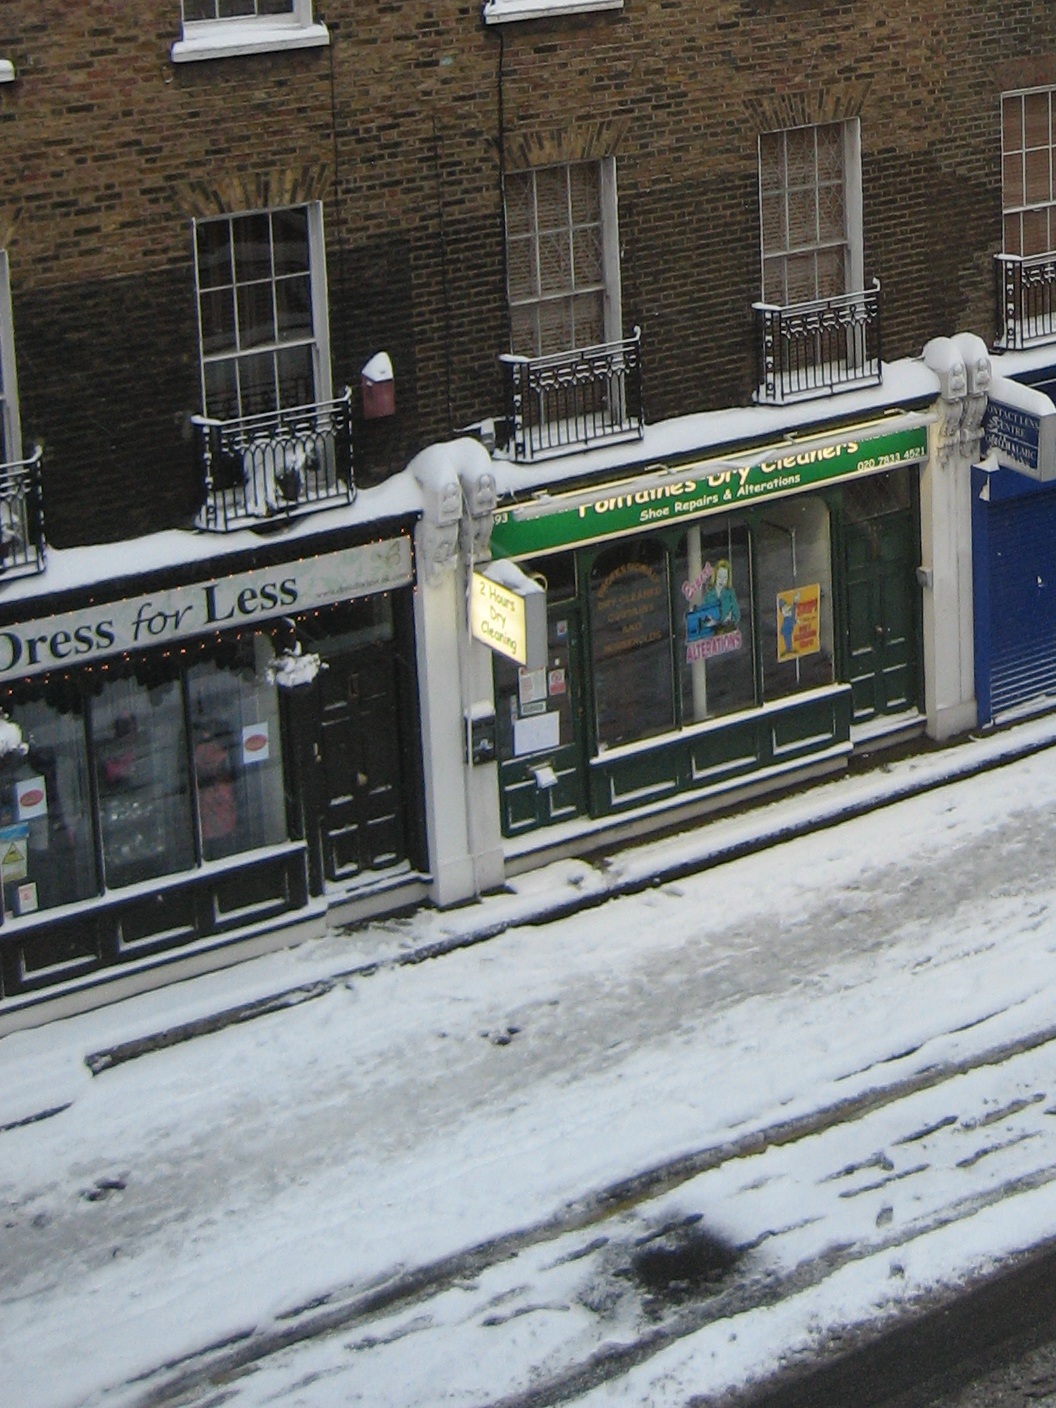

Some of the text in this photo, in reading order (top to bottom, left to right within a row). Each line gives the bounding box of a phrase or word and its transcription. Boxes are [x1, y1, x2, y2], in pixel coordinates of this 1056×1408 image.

[857, 446, 925, 472] 020 7833 4521
[640, 474, 801, 522] Shoe Repairs & Alterations
[479, 581, 516, 613] 2 Hours
[0, 618, 115, 673] Dress
[132, 602, 193, 641] for
[204, 577, 299, 624] Less
[489, 604, 507, 630] Dry
[480, 620, 518, 655] Cleaning
[686, 631, 742, 663] ALTERATIONS
